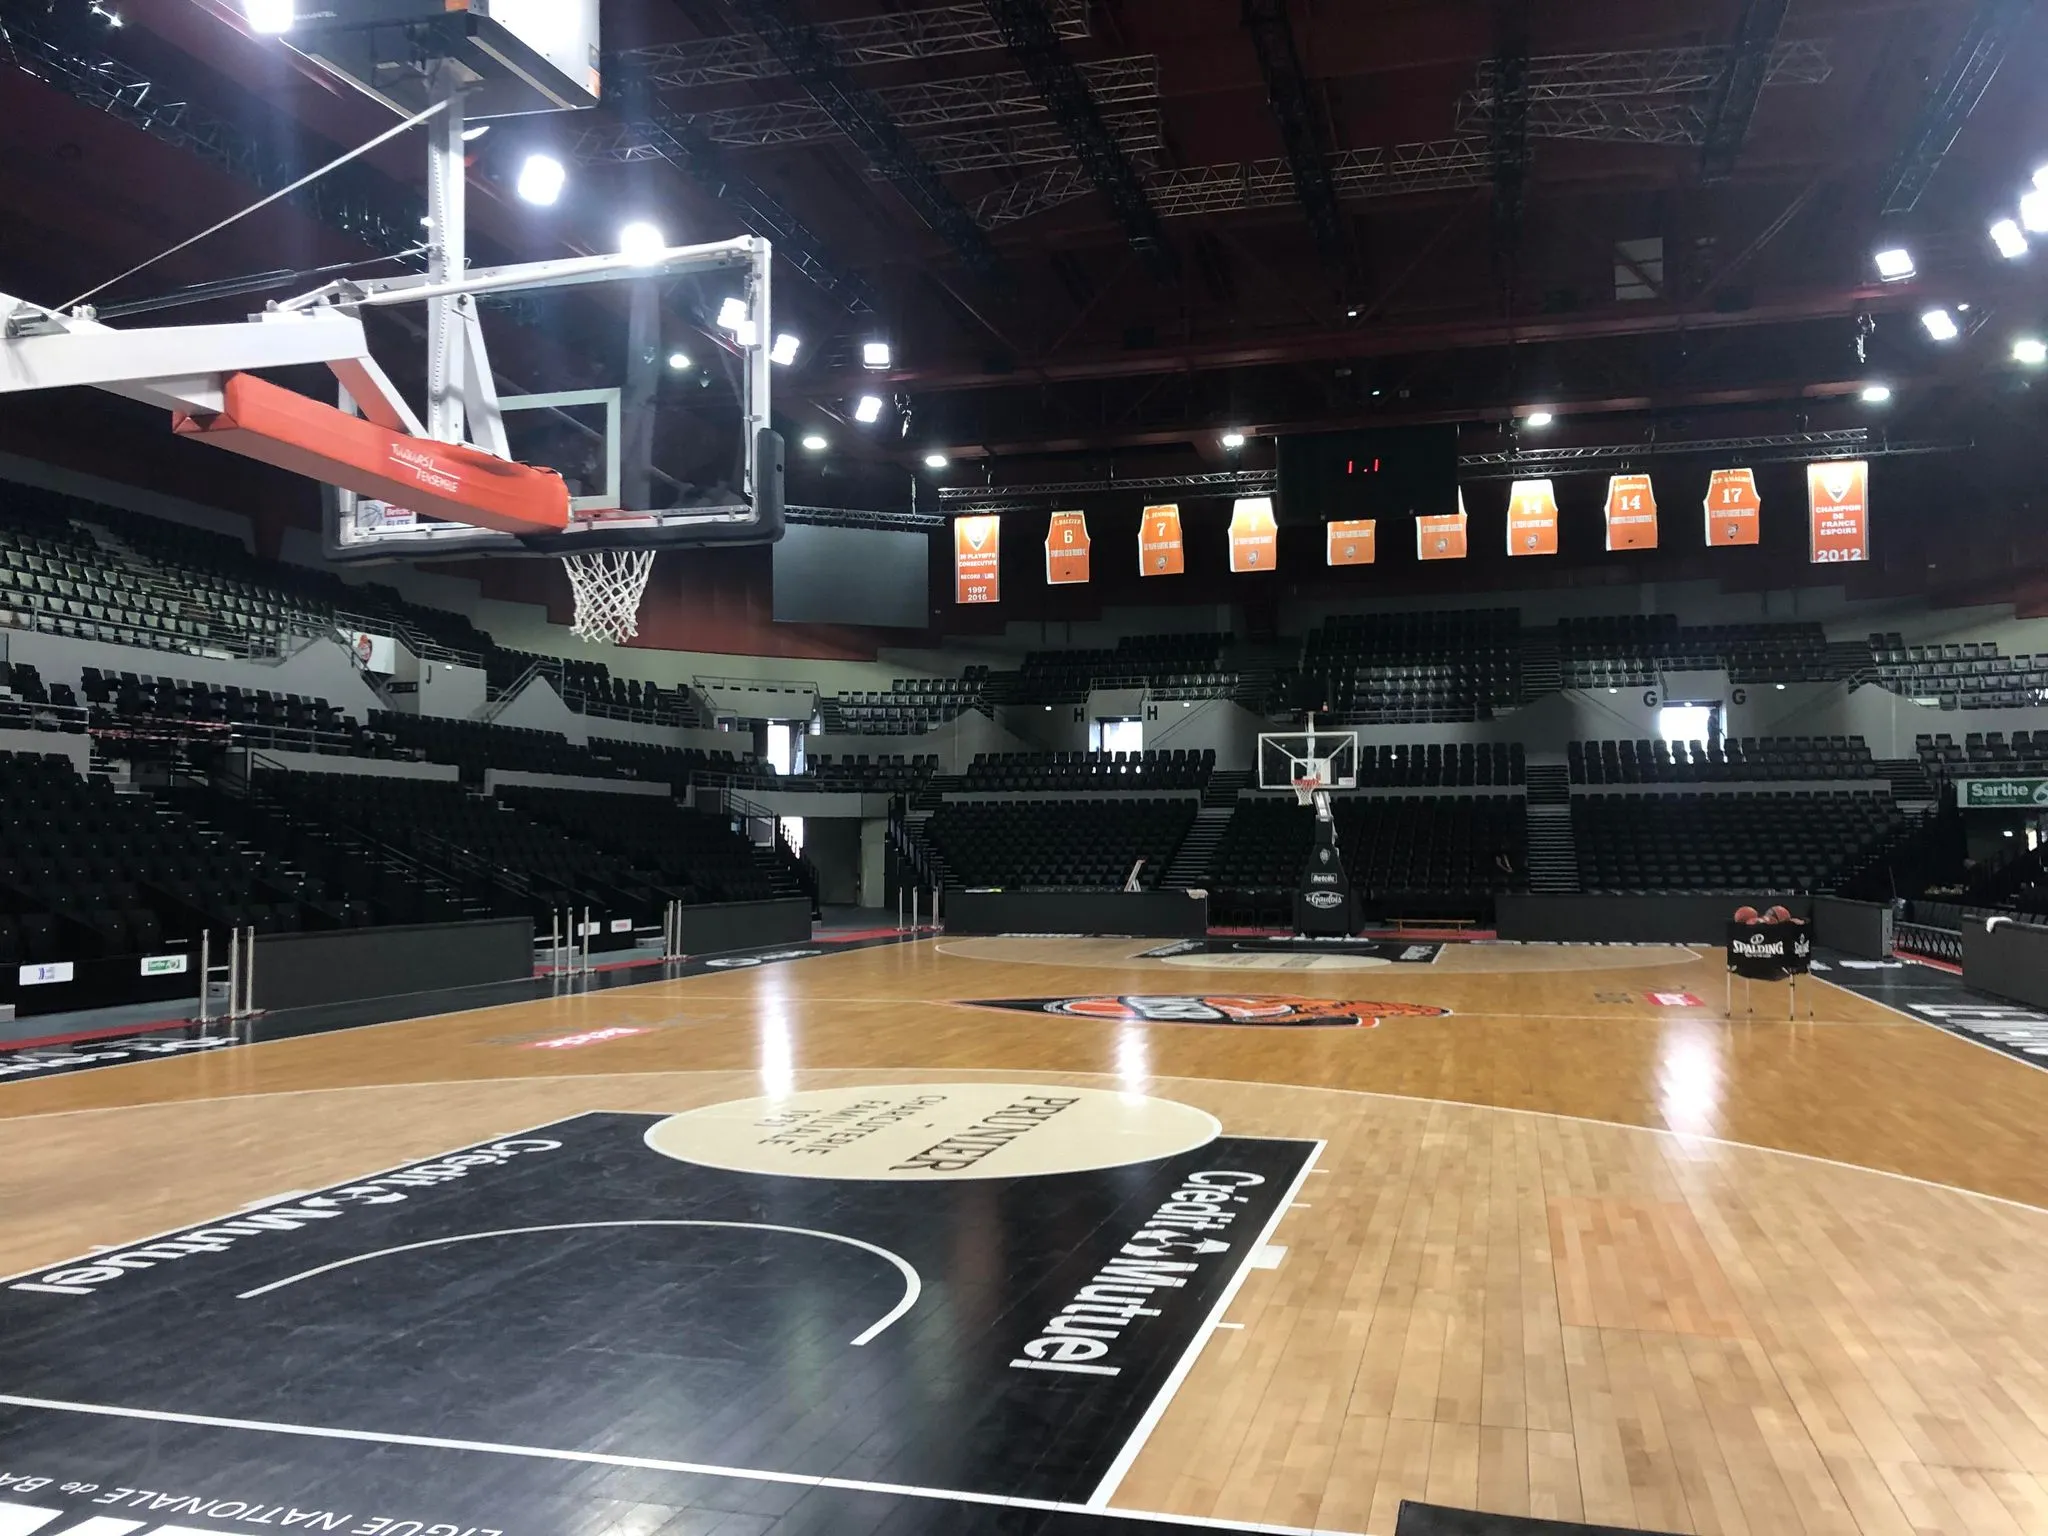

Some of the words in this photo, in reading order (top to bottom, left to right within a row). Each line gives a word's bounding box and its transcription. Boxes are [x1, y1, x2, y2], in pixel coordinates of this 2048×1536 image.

[1621, 494, 1641, 511] 14
[1722, 487, 1743, 504] 17
[1815, 504, 1862, 514] CHAMPION
[1832, 512, 1844, 520] DE
[1156, 522, 1167, 537] 7
[1821, 519, 1856, 528] FRANCE
[1064, 529, 1073, 544] 6
[1820, 528, 1857, 536] ESPOIRS
[1817, 548, 1862, 562] 2012
[967, 585, 987, 594] 1997
[967, 593, 988, 601] 2016
[1643, 690, 1658, 707] G
[1732, 688, 1747, 705] G
[1073, 707, 1085, 722] H
[1147, 705, 1158, 721] H
[1971, 783, 2029, 797] Sarthe
[1733, 939, 1785, 955] SPALDING
[757, 1100, 891, 1146] FAMILIALE
[791, 1095, 948, 1155] CHARCUTERIE
[888, 1096, 1081, 1172] PRUNIER
[377, 1138, 563, 1187] Crédit
[1144, 1171, 1266, 1230] Crédit
[9, 1208, 344, 1294] Mutuel
[1009, 1257, 1199, 1376] Mutuel
[60, 1481, 100, 1495] de
[92, 1487, 353, 1531] NATIONALE
